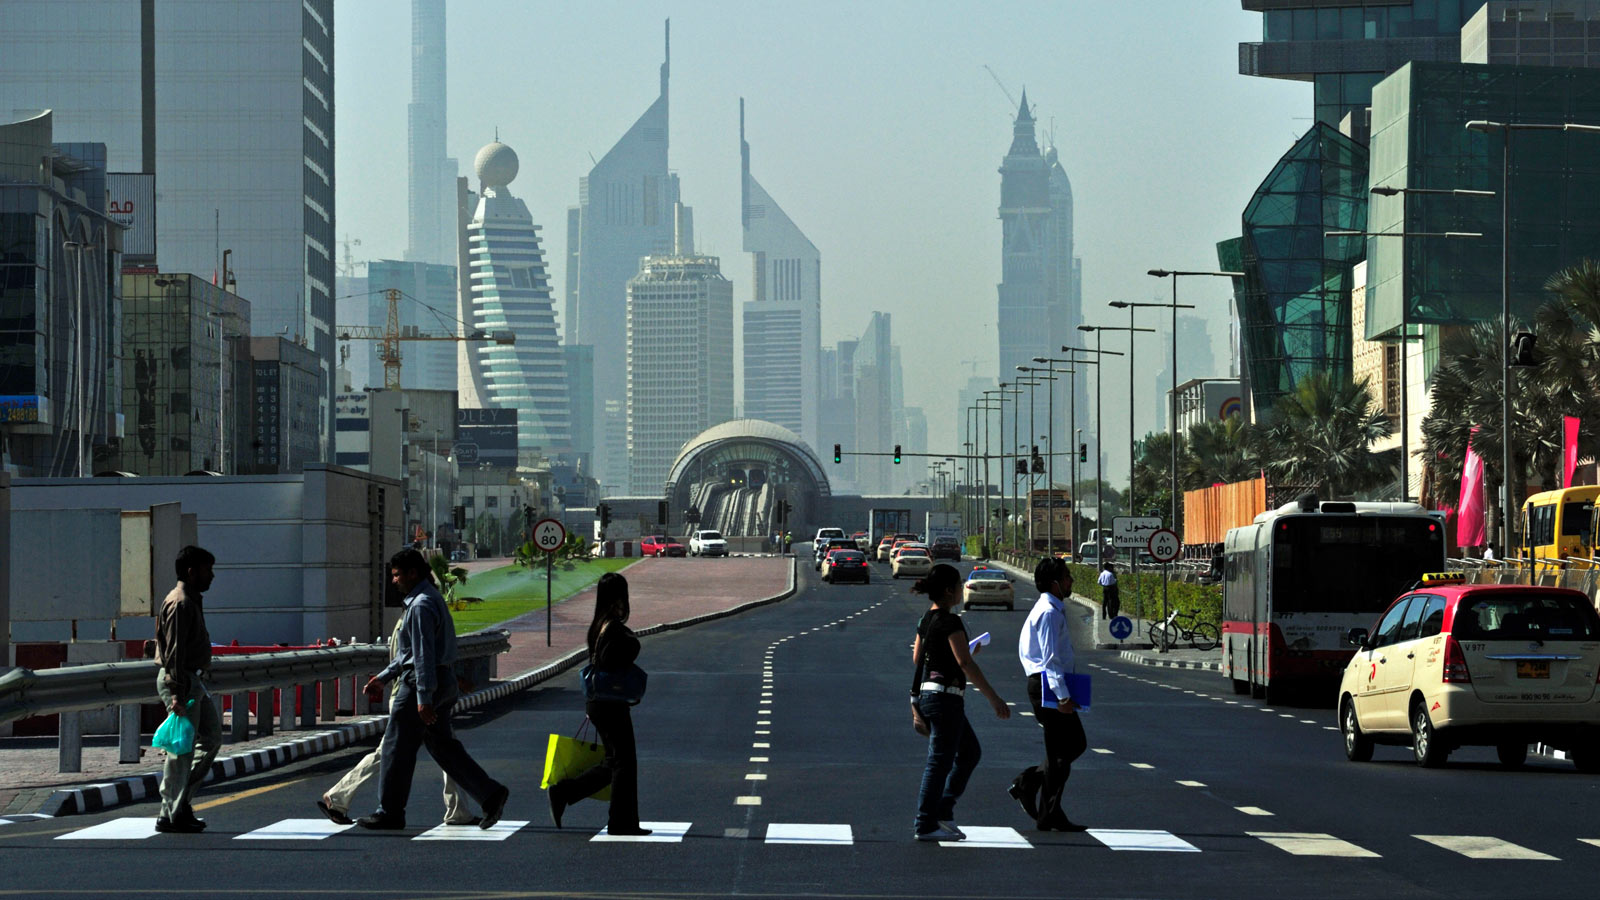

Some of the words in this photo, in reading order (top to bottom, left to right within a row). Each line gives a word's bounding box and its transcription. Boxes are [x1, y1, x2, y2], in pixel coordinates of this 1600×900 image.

[541, 535, 557, 545] 80
[1115, 535, 1150, 543] Mankho
[1157, 546, 1172, 555] 80
